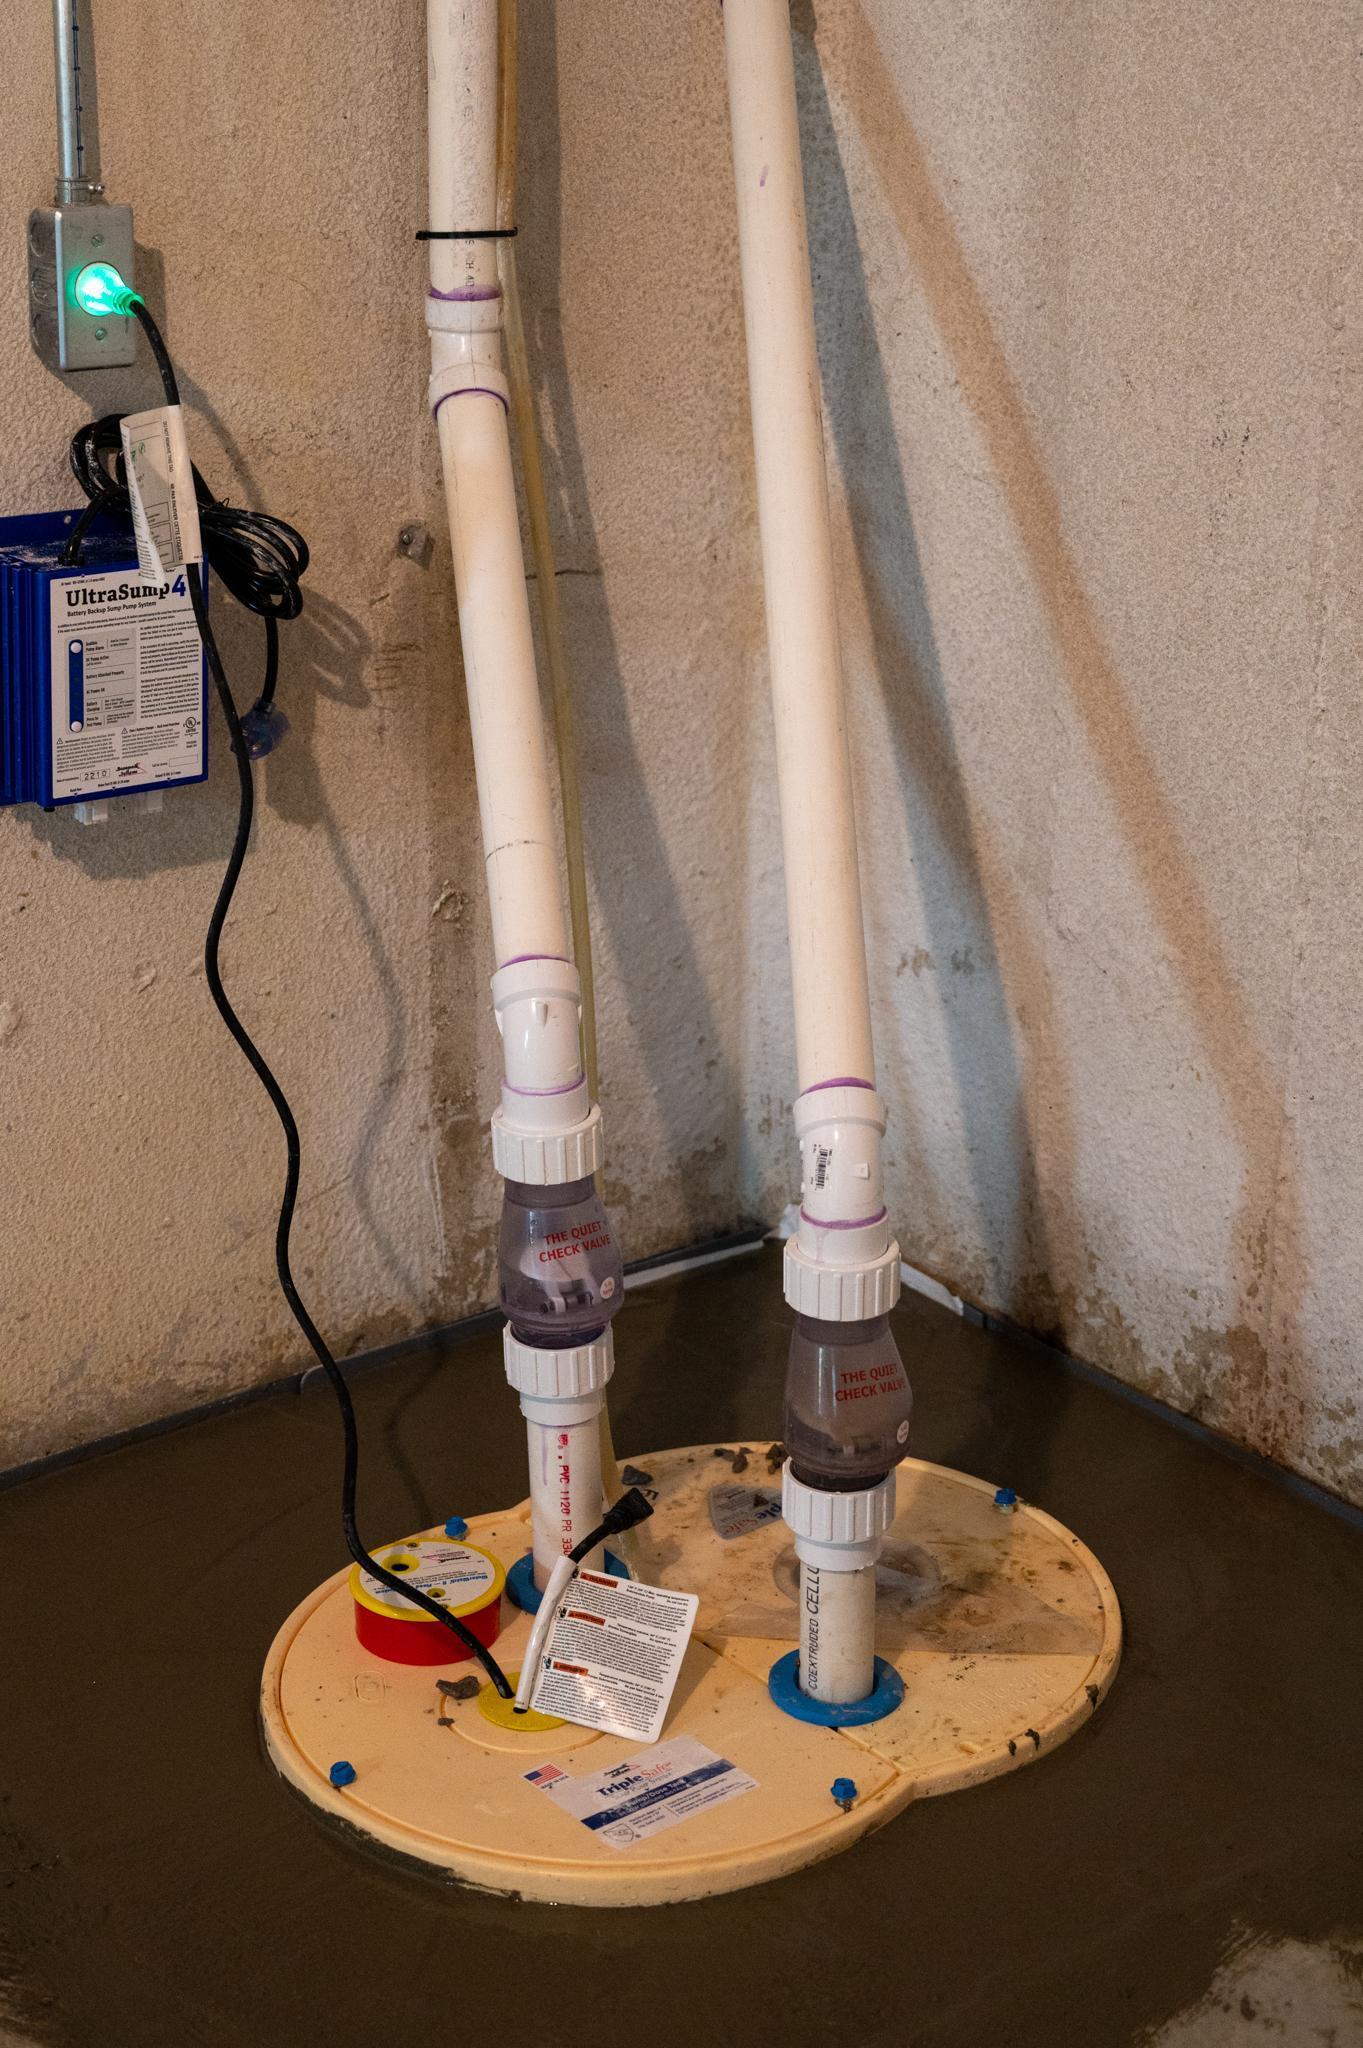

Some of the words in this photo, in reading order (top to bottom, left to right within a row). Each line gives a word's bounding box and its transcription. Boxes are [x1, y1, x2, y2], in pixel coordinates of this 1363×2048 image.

[67, 609, 87, 617] Battery
[88, 608, 106, 616] Backup
[107, 605, 122, 613] Sump
[122, 602, 137, 610] Pump
[138, 601, 156, 609] System
[544, 1231, 568, 1245] THE
[572, 1221, 601, 1239] QUIET
[539, 1244, 580, 1262] CHECK
[582, 1234, 611, 1251] VALVE
[841, 1370, 866, 1384] THE
[870, 1364, 898, 1380] QUIET
[835, 1384, 878, 1402] CHECK
[560, 1465, 570, 1484] PVC
[560, 1491, 571, 1516] 1120
[562, 1520, 572, 1532] PR
[808, 1619, 819, 1690] COEXTRUDED
